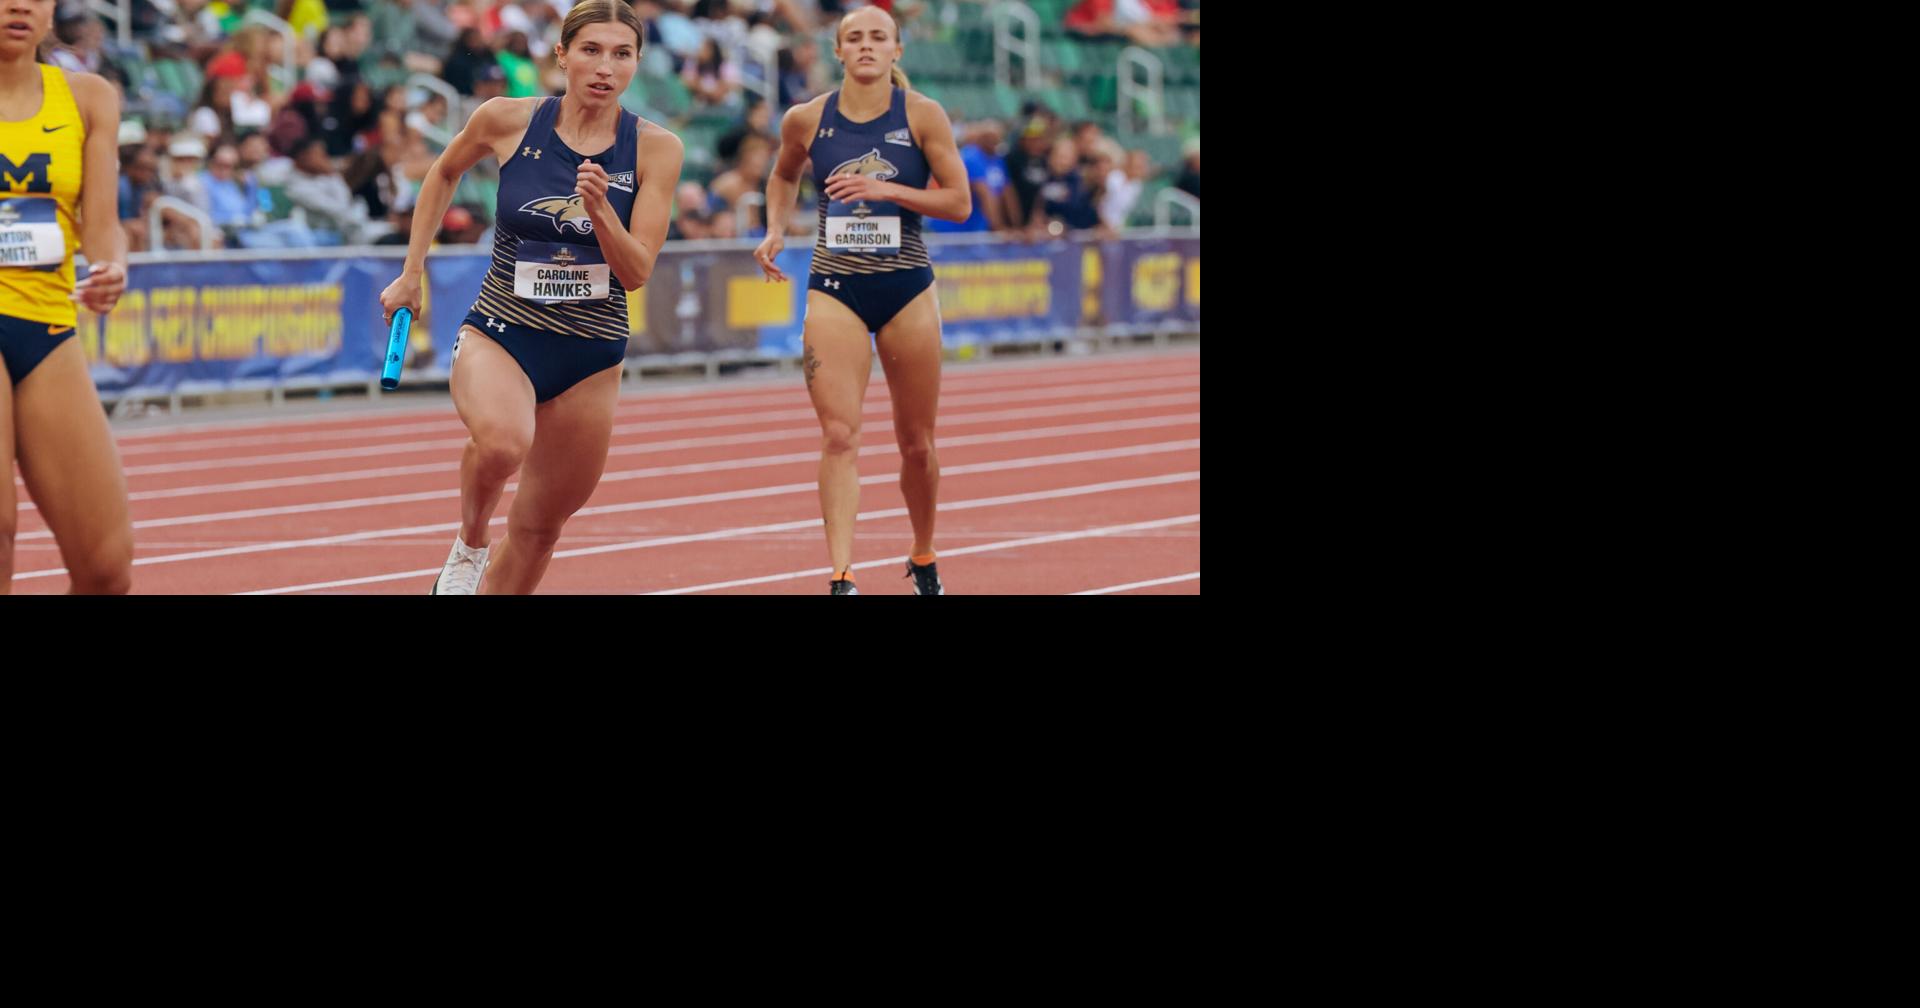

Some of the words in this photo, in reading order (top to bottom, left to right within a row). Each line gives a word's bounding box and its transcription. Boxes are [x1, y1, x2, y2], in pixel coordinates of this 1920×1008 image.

[846, 222, 878, 231] PEYTON
[835, 233, 891, 245] GARRISON
[537, 269, 589, 280] CAROLINE
[533, 282, 592, 297] HAWKES
